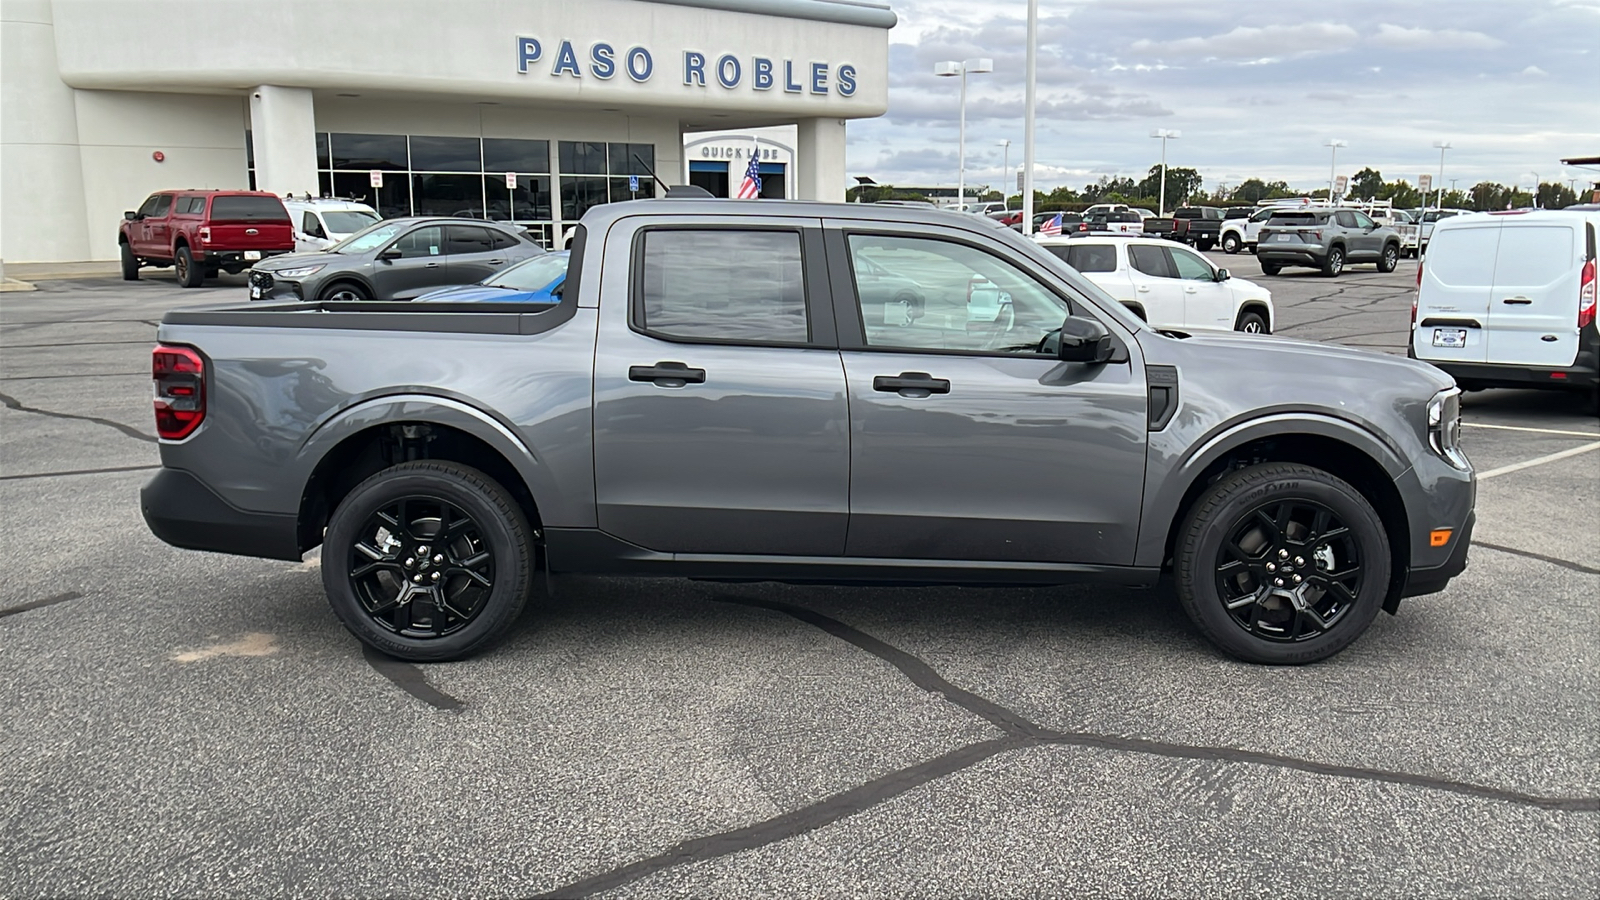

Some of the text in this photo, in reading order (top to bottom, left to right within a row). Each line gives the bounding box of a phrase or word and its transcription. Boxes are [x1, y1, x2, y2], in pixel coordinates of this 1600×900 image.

[516, 35, 857, 97] PASO ROBLES
[702, 146, 742, 159] QUICK
